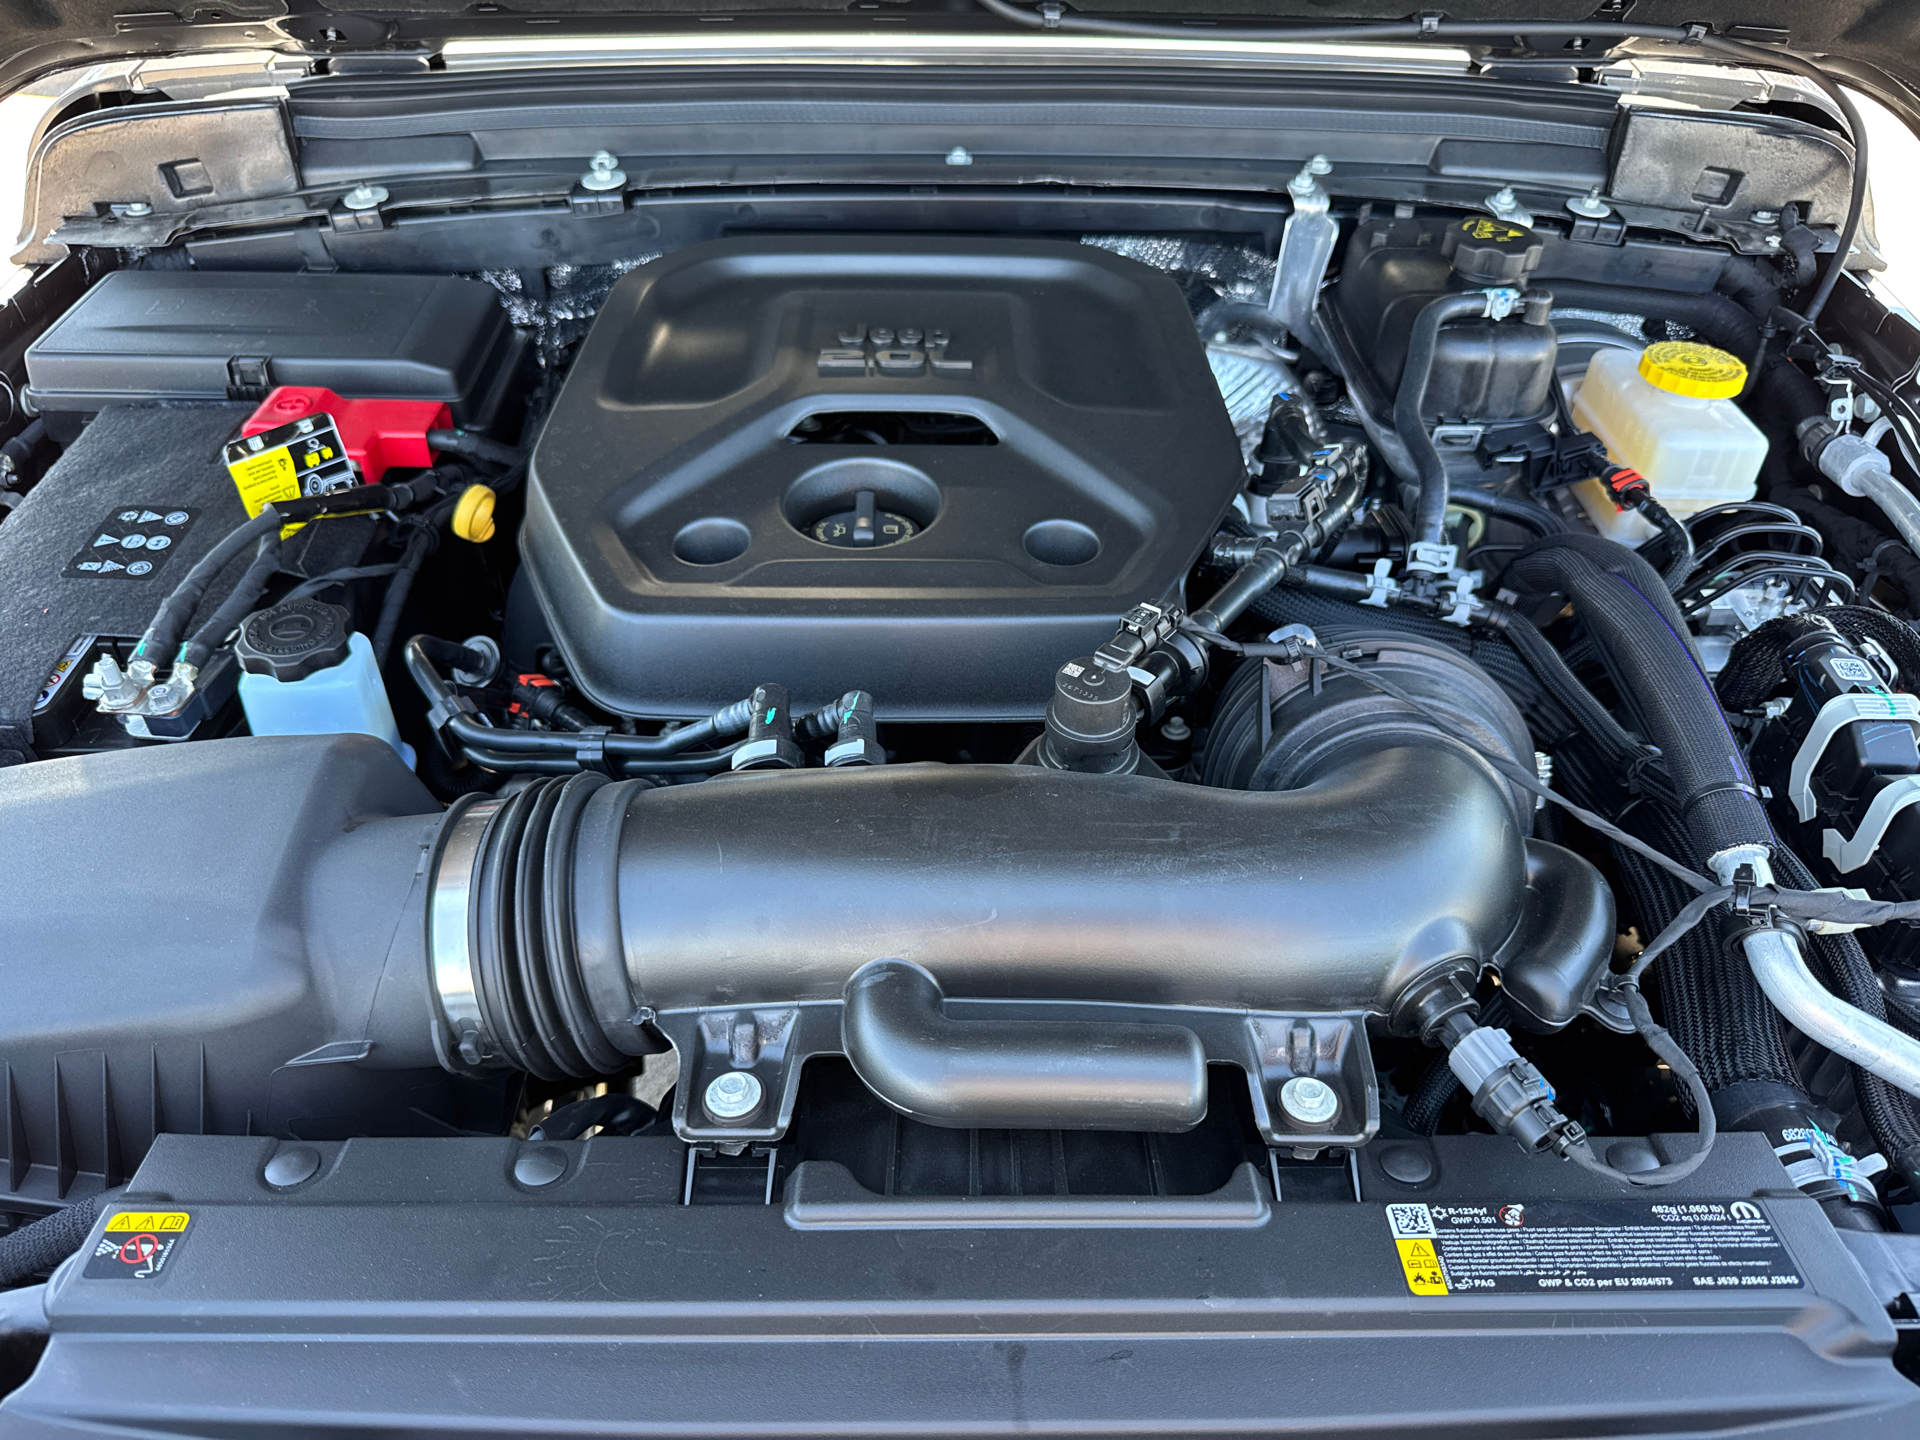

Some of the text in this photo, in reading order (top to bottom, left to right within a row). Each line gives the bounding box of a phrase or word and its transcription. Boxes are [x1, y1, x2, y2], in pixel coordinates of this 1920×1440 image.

[838, 323, 949, 348] Jeep
[1450, 1216, 1497, 1224] GWP 0.501
[1681, 1215, 1694, 1223] eq
[1692, 1214, 1726, 1222] 0.00024
[1474, 1278, 1496, 1287] PAG
[1538, 1278, 1563, 1288] GWP
[1564, 1278, 1573, 1287] &
[1573, 1278, 1596, 1287] CO2
[1613, 1277, 1630, 1287] EU
[1630, 1277, 1674, 1287] 2024/573
[1692, 1275, 1800, 1286] SAE J639 J2842 J2845
